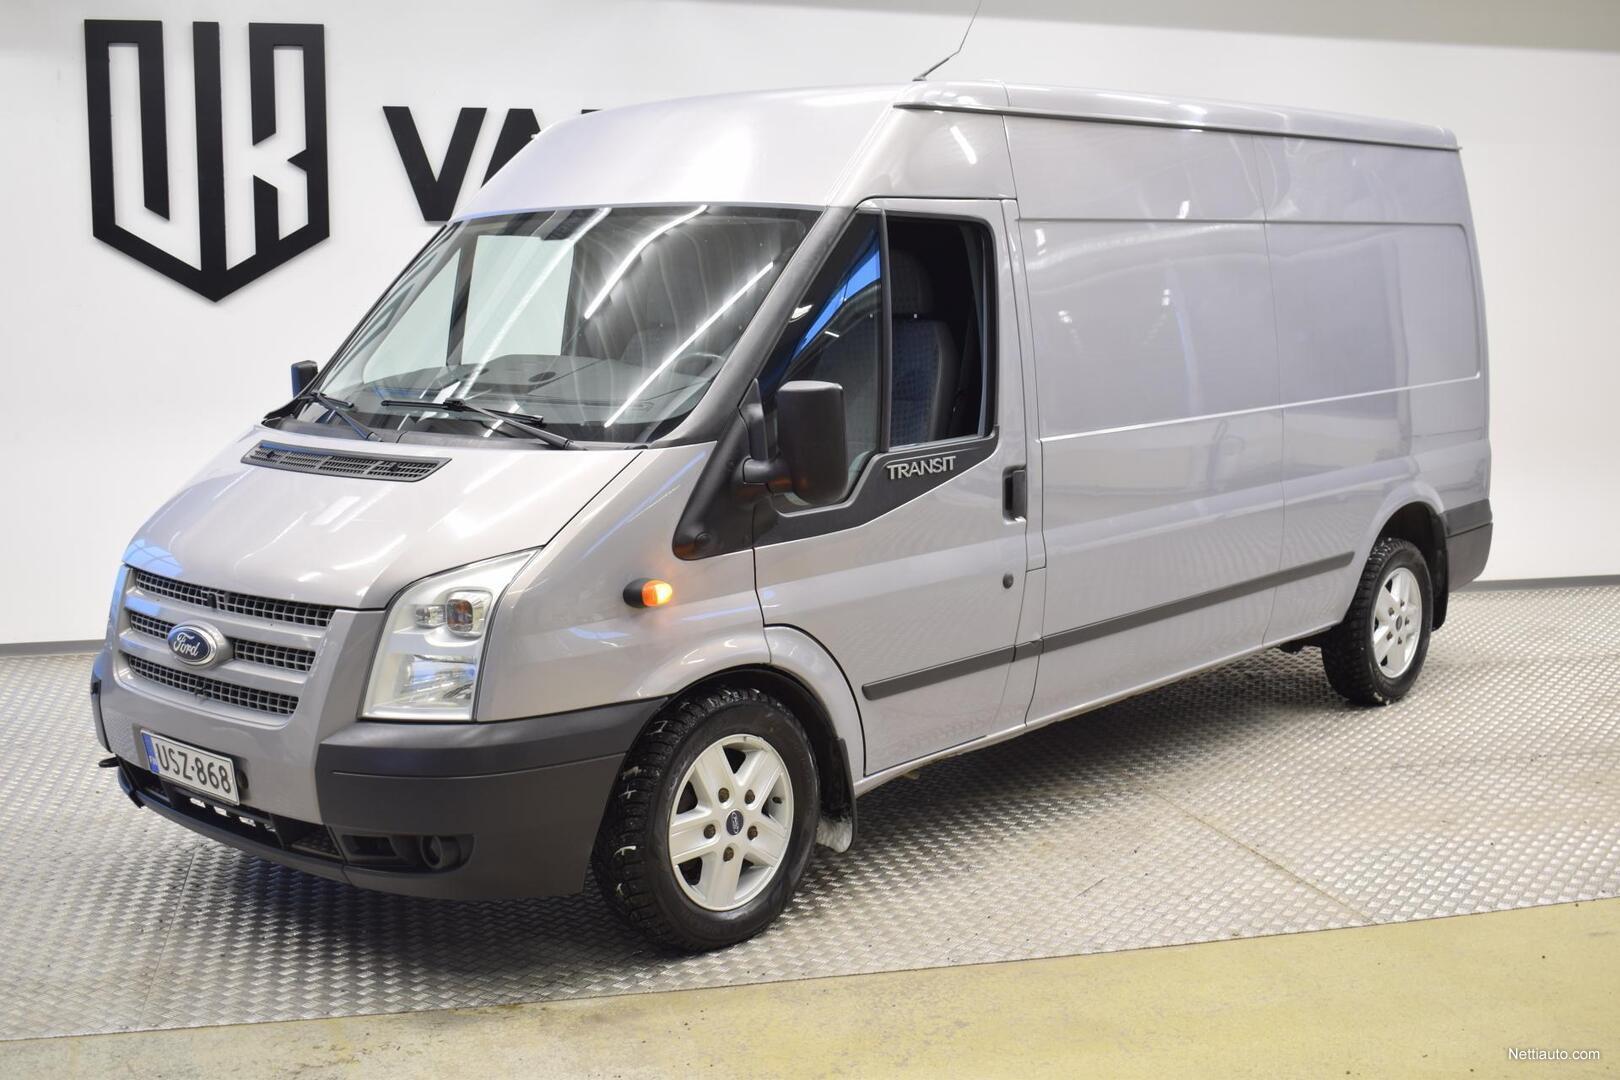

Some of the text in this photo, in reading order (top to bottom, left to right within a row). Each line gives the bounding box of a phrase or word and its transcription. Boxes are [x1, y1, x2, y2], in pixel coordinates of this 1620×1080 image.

[887, 456, 956, 480] TRANSIT
[173, 632, 201, 657] Ford
[155, 743, 232, 794] USZ-868
